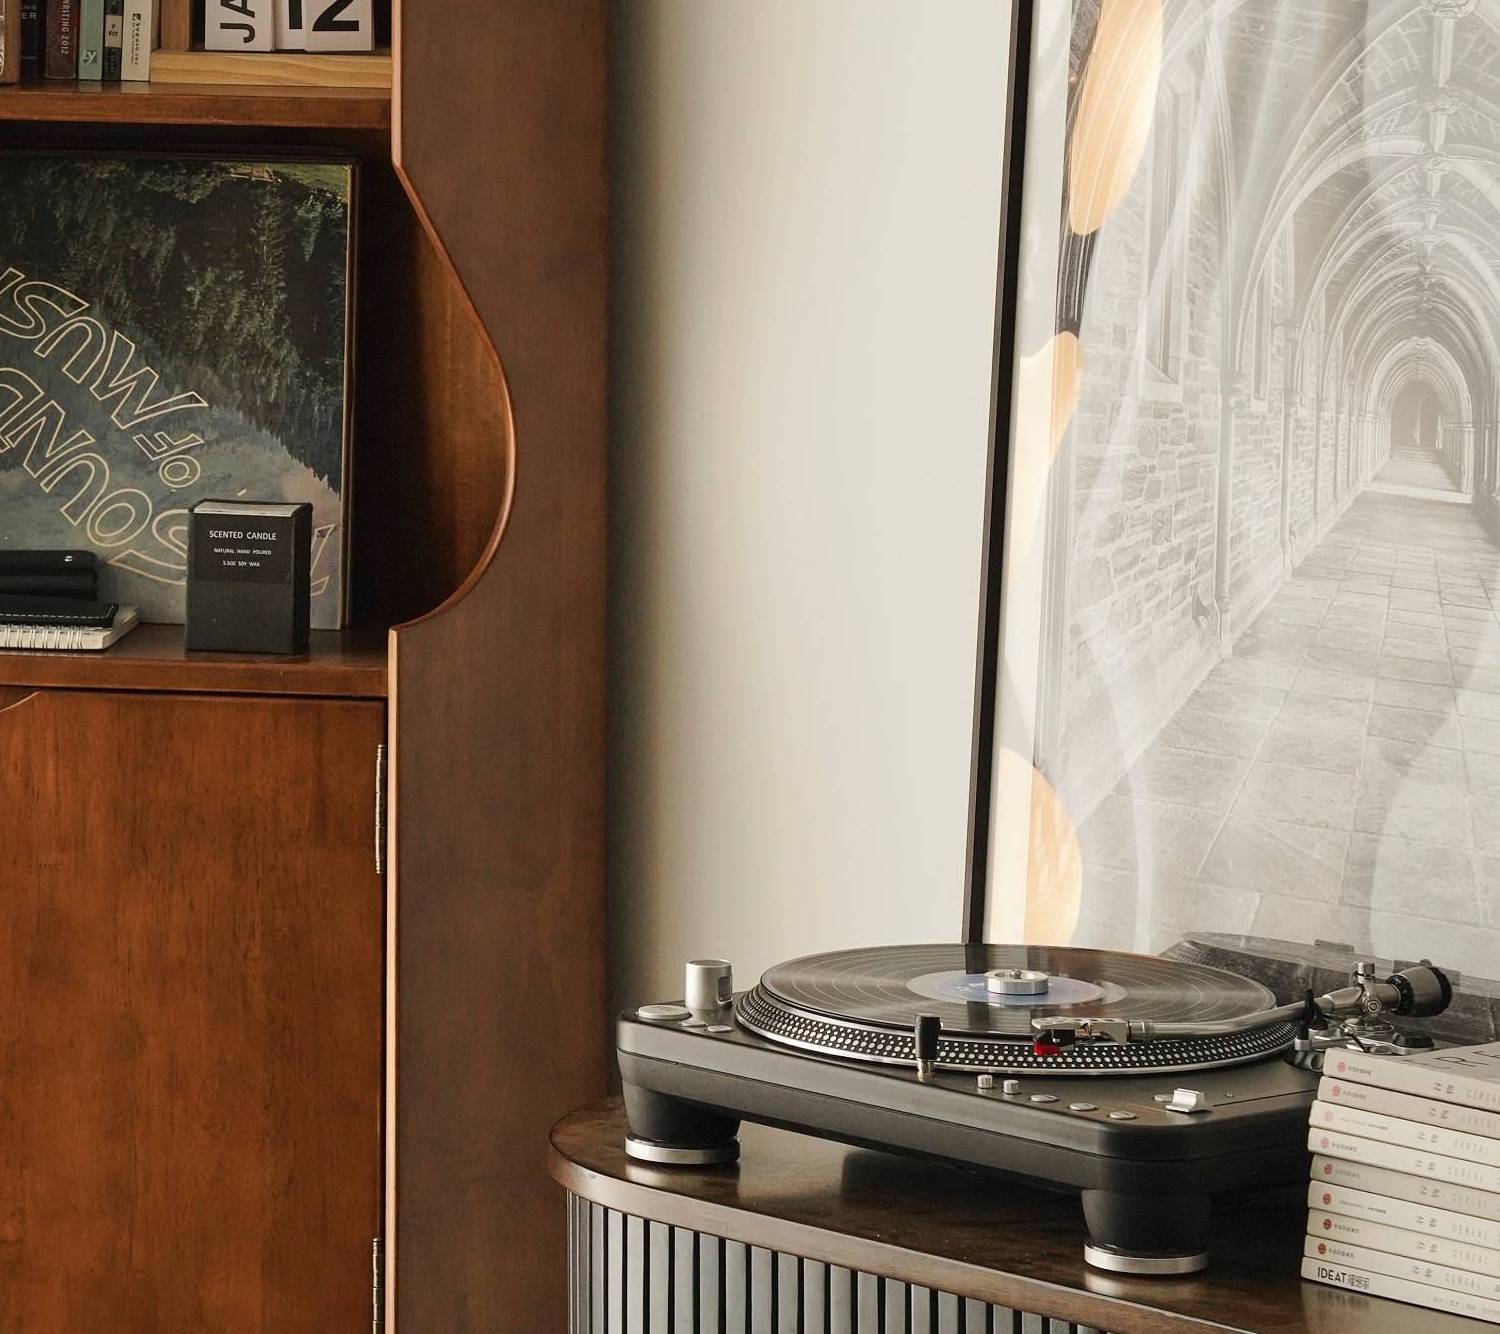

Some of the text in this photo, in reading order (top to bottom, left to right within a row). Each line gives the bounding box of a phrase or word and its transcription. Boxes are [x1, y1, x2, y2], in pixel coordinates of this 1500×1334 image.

[60, 34, 70, 55] 2012
[133, 431, 205, 488] OF
[209, 530, 277, 541] SCENTED CANDLE
[1317, 1266, 1348, 1284] IDEAT
